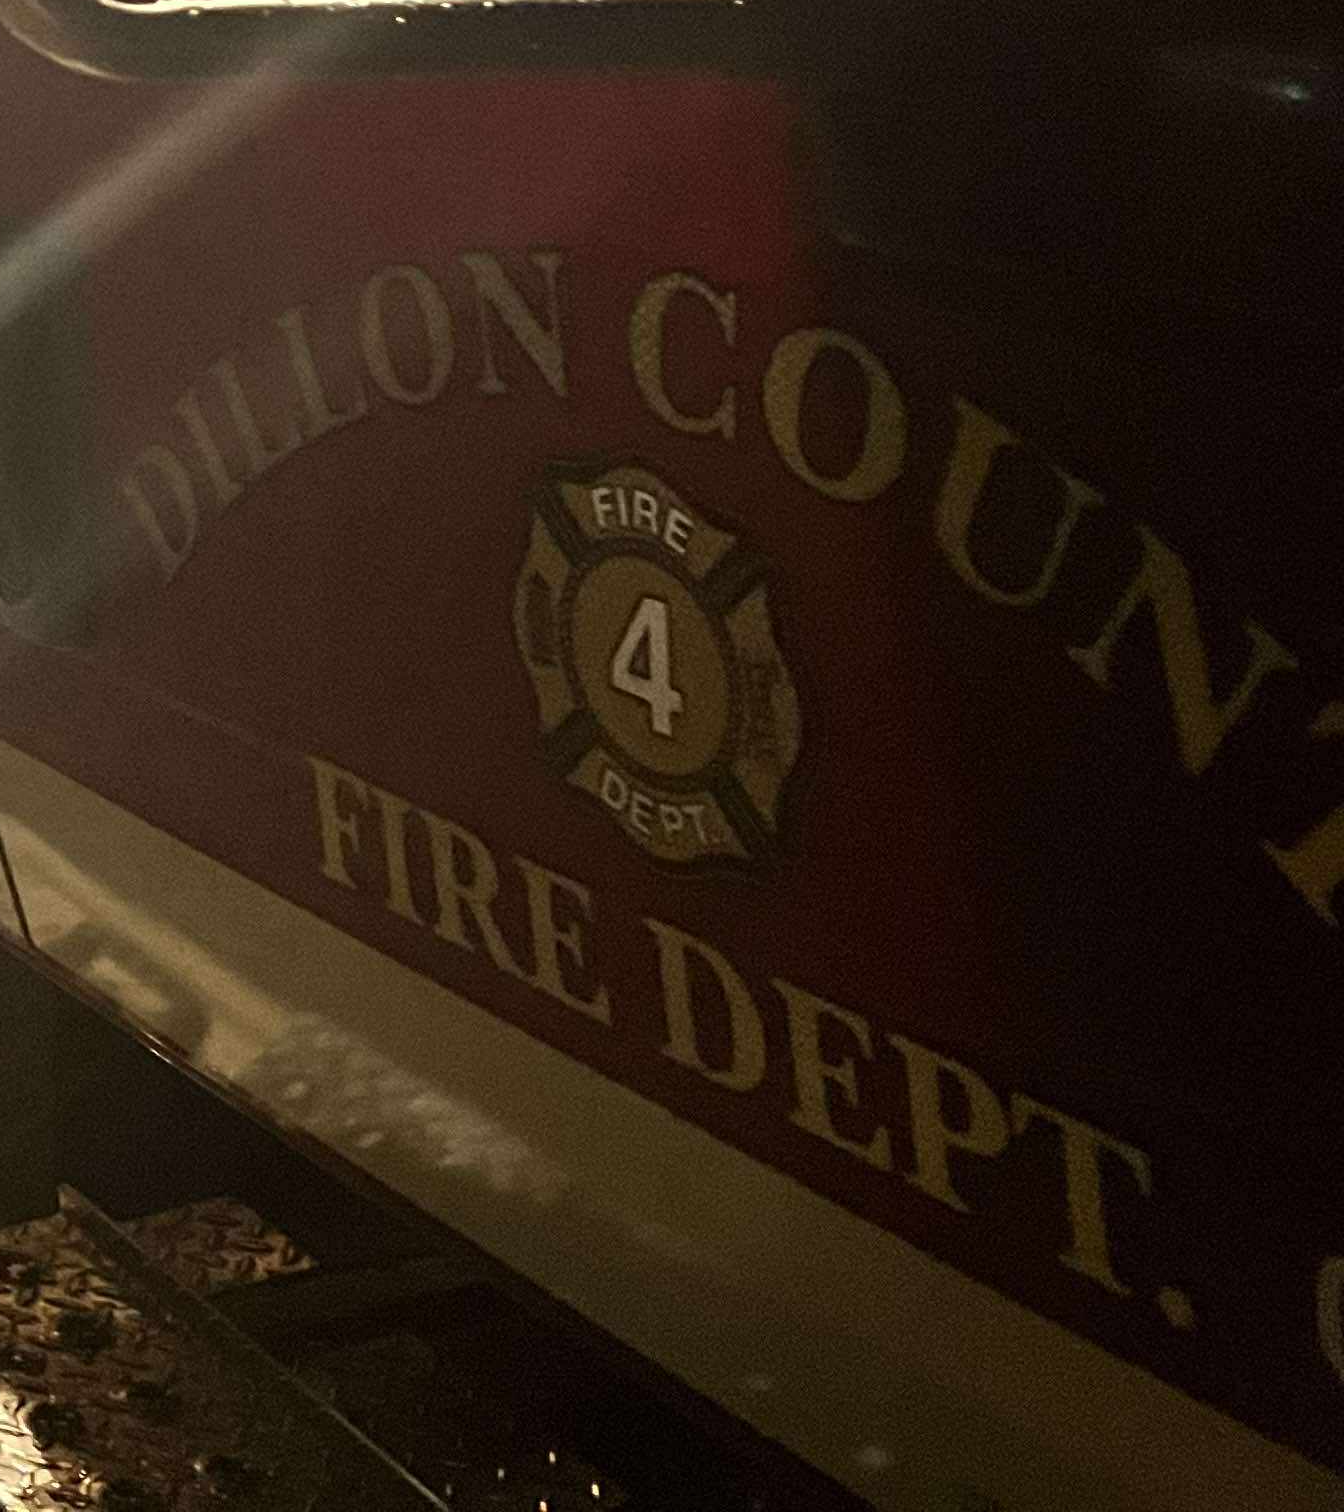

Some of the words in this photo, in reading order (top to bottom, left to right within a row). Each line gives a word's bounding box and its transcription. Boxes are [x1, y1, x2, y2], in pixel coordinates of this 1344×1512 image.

[121, 250, 569, 585] DILLON
[591, 486, 695, 555] FIRE
[612, 596, 684, 737] 4
[306, 752, 612, 1027] FIRE
[641, 916, 1197, 1331] DEPT.
